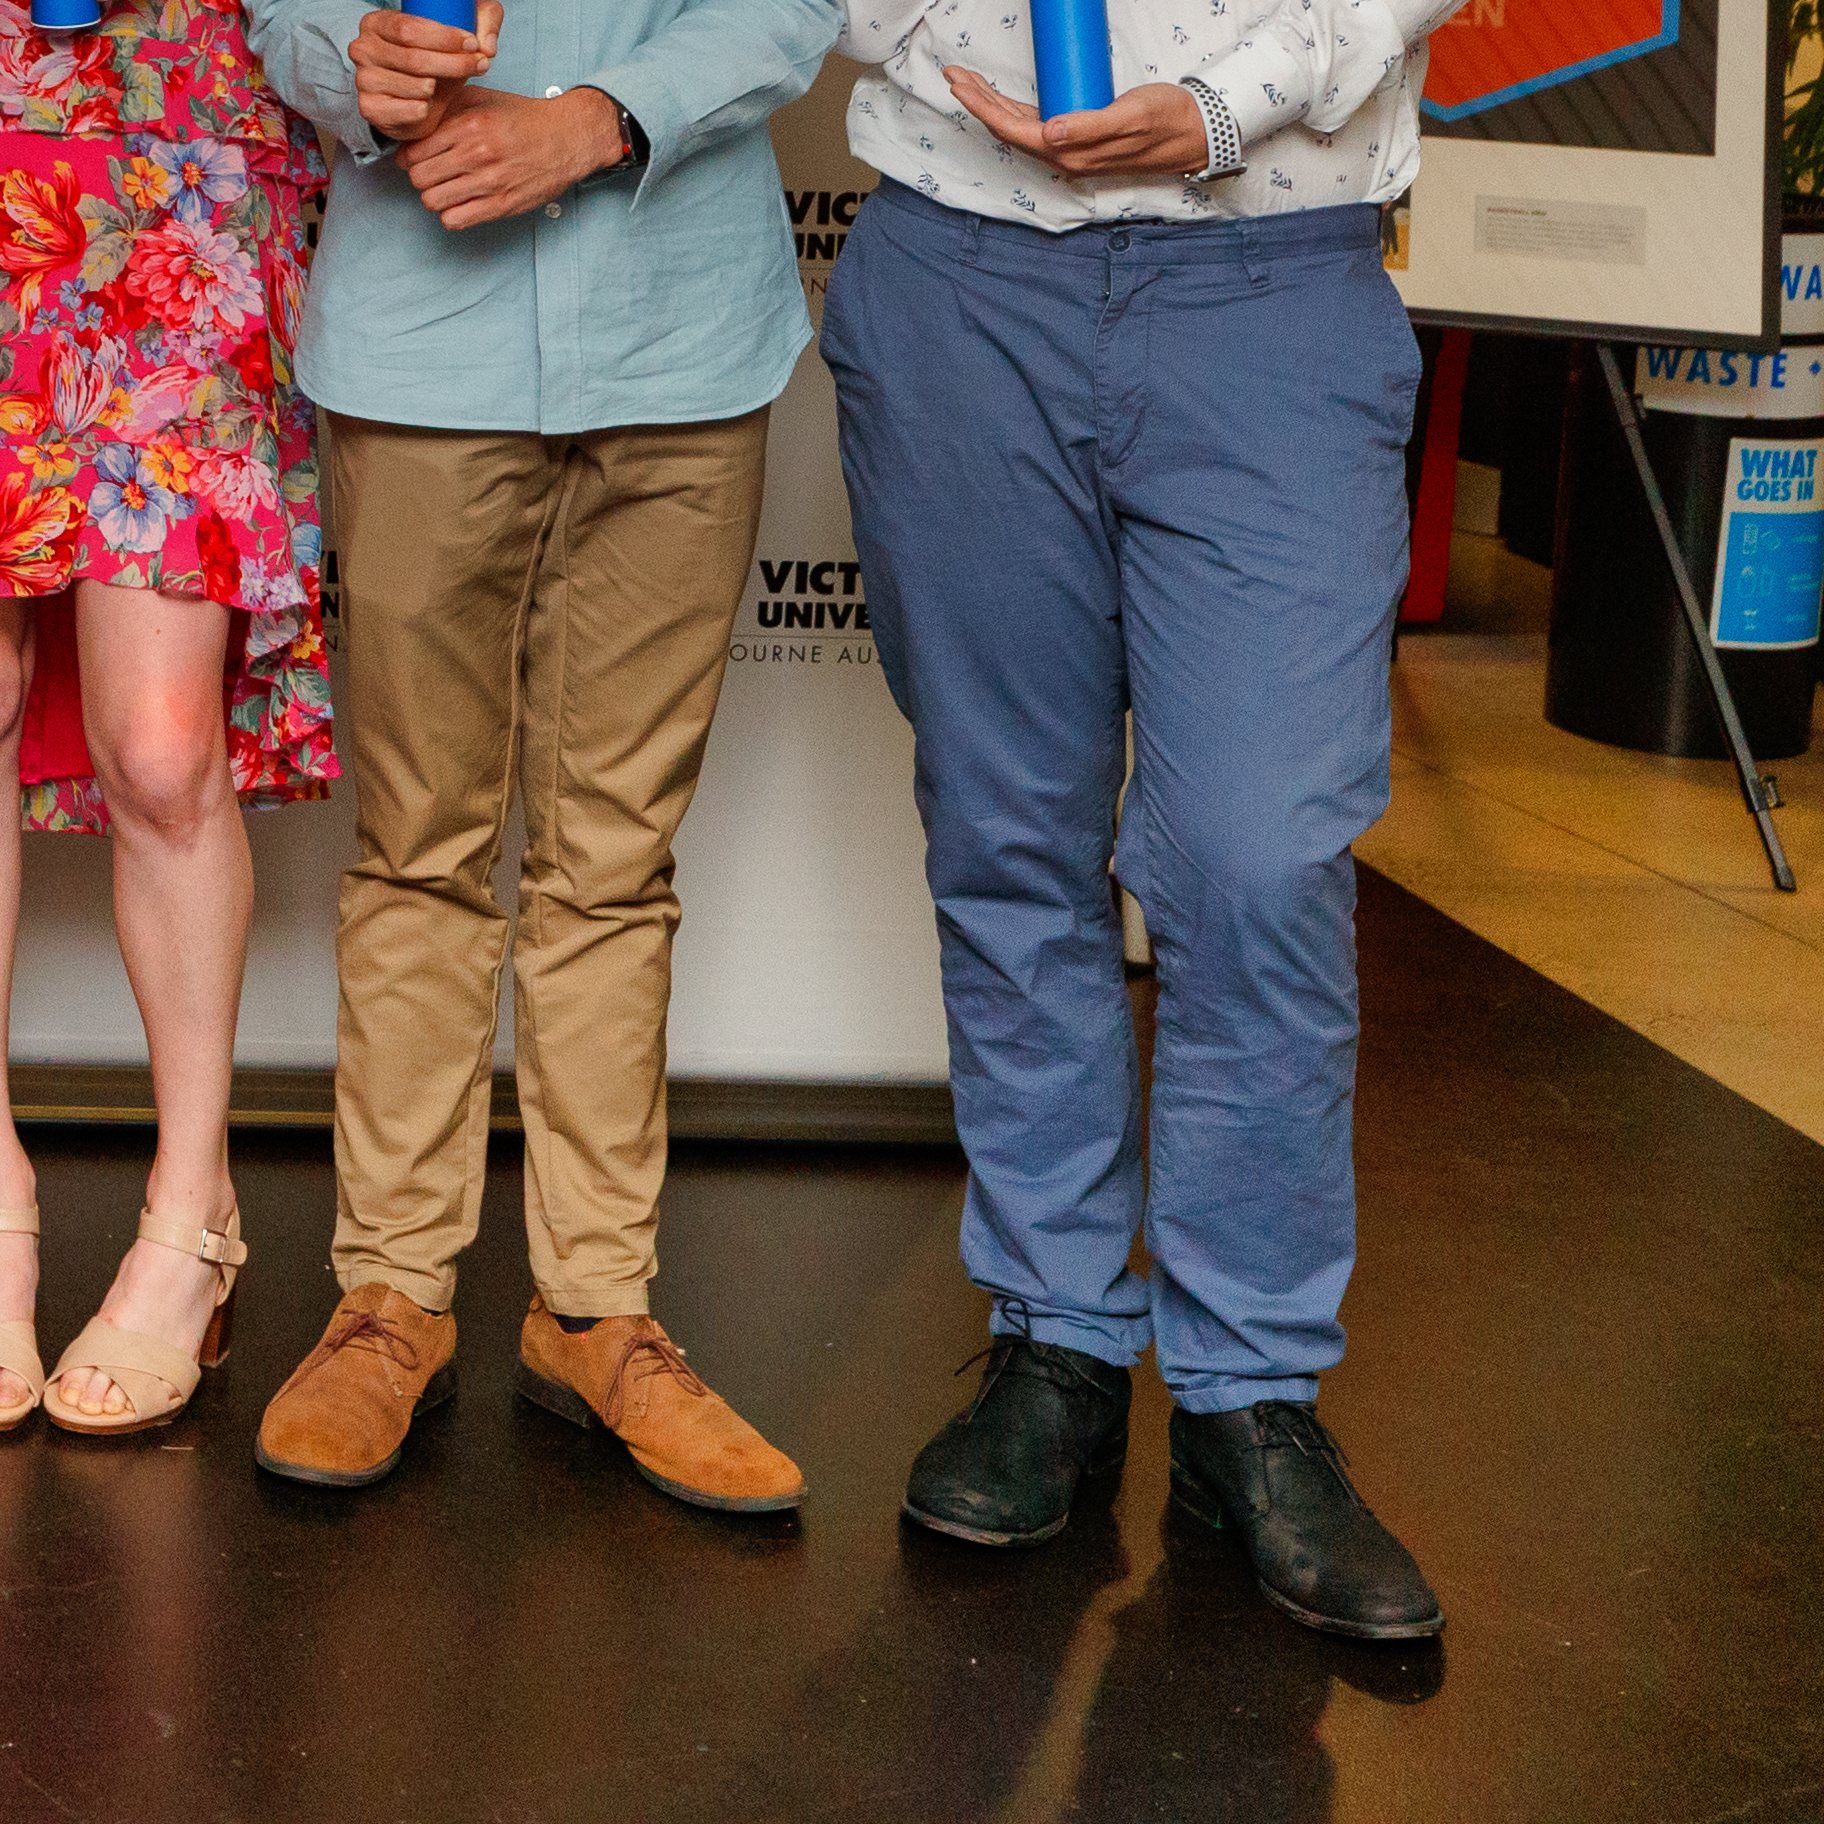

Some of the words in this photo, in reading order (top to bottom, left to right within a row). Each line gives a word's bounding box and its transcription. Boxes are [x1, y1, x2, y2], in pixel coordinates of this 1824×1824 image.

[1644, 347, 1788, 389] WASTE
[1740, 447, 1818, 480] WHAT
[1736, 478, 1793, 502] GOES
[1796, 478, 1815, 502] IN
